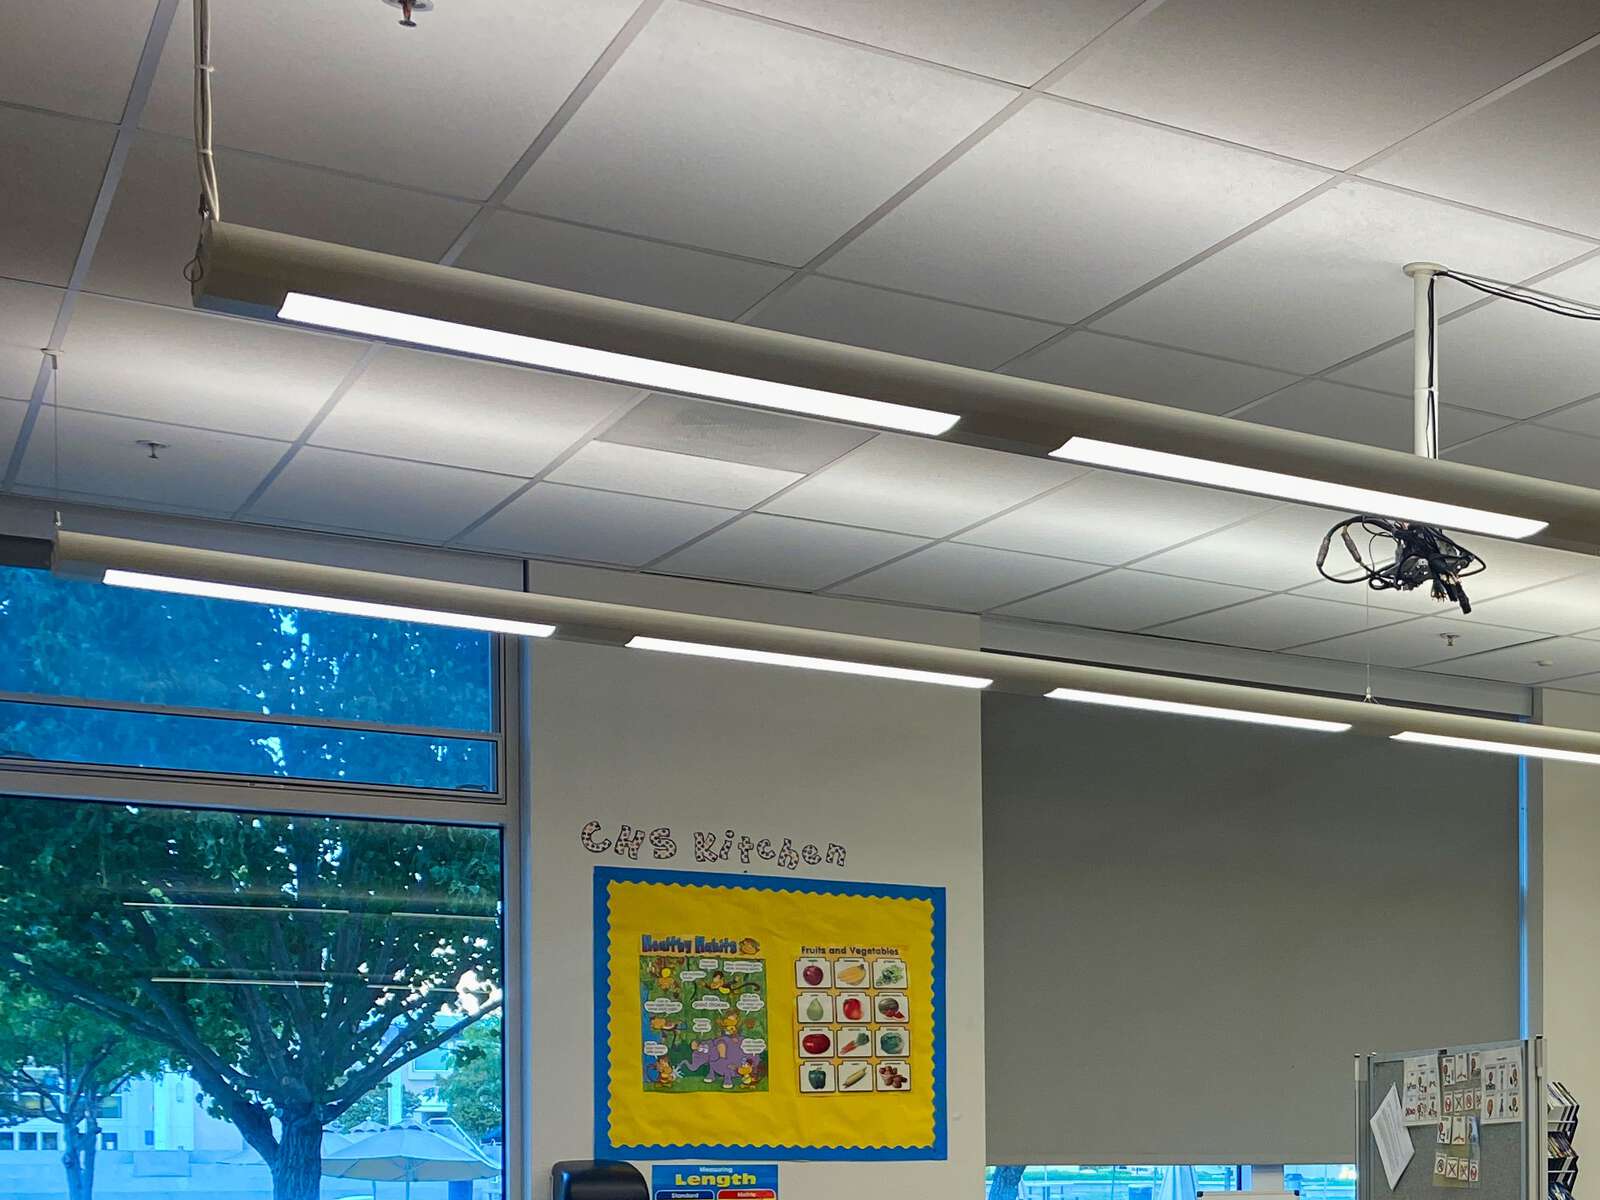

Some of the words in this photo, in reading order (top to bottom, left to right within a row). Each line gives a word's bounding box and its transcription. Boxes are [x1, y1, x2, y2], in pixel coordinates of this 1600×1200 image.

[581, 820, 677, 860] CHS
[693, 830, 847, 870] Kitchen
[642, 934, 692, 953] Healthy
[695, 935, 737, 954] Habits
[801, 946, 826, 955] Fruits
[829, 946, 847, 954] and
[849, 946, 899, 956] Vegetables
[675, 1173, 757, 1188] Length
